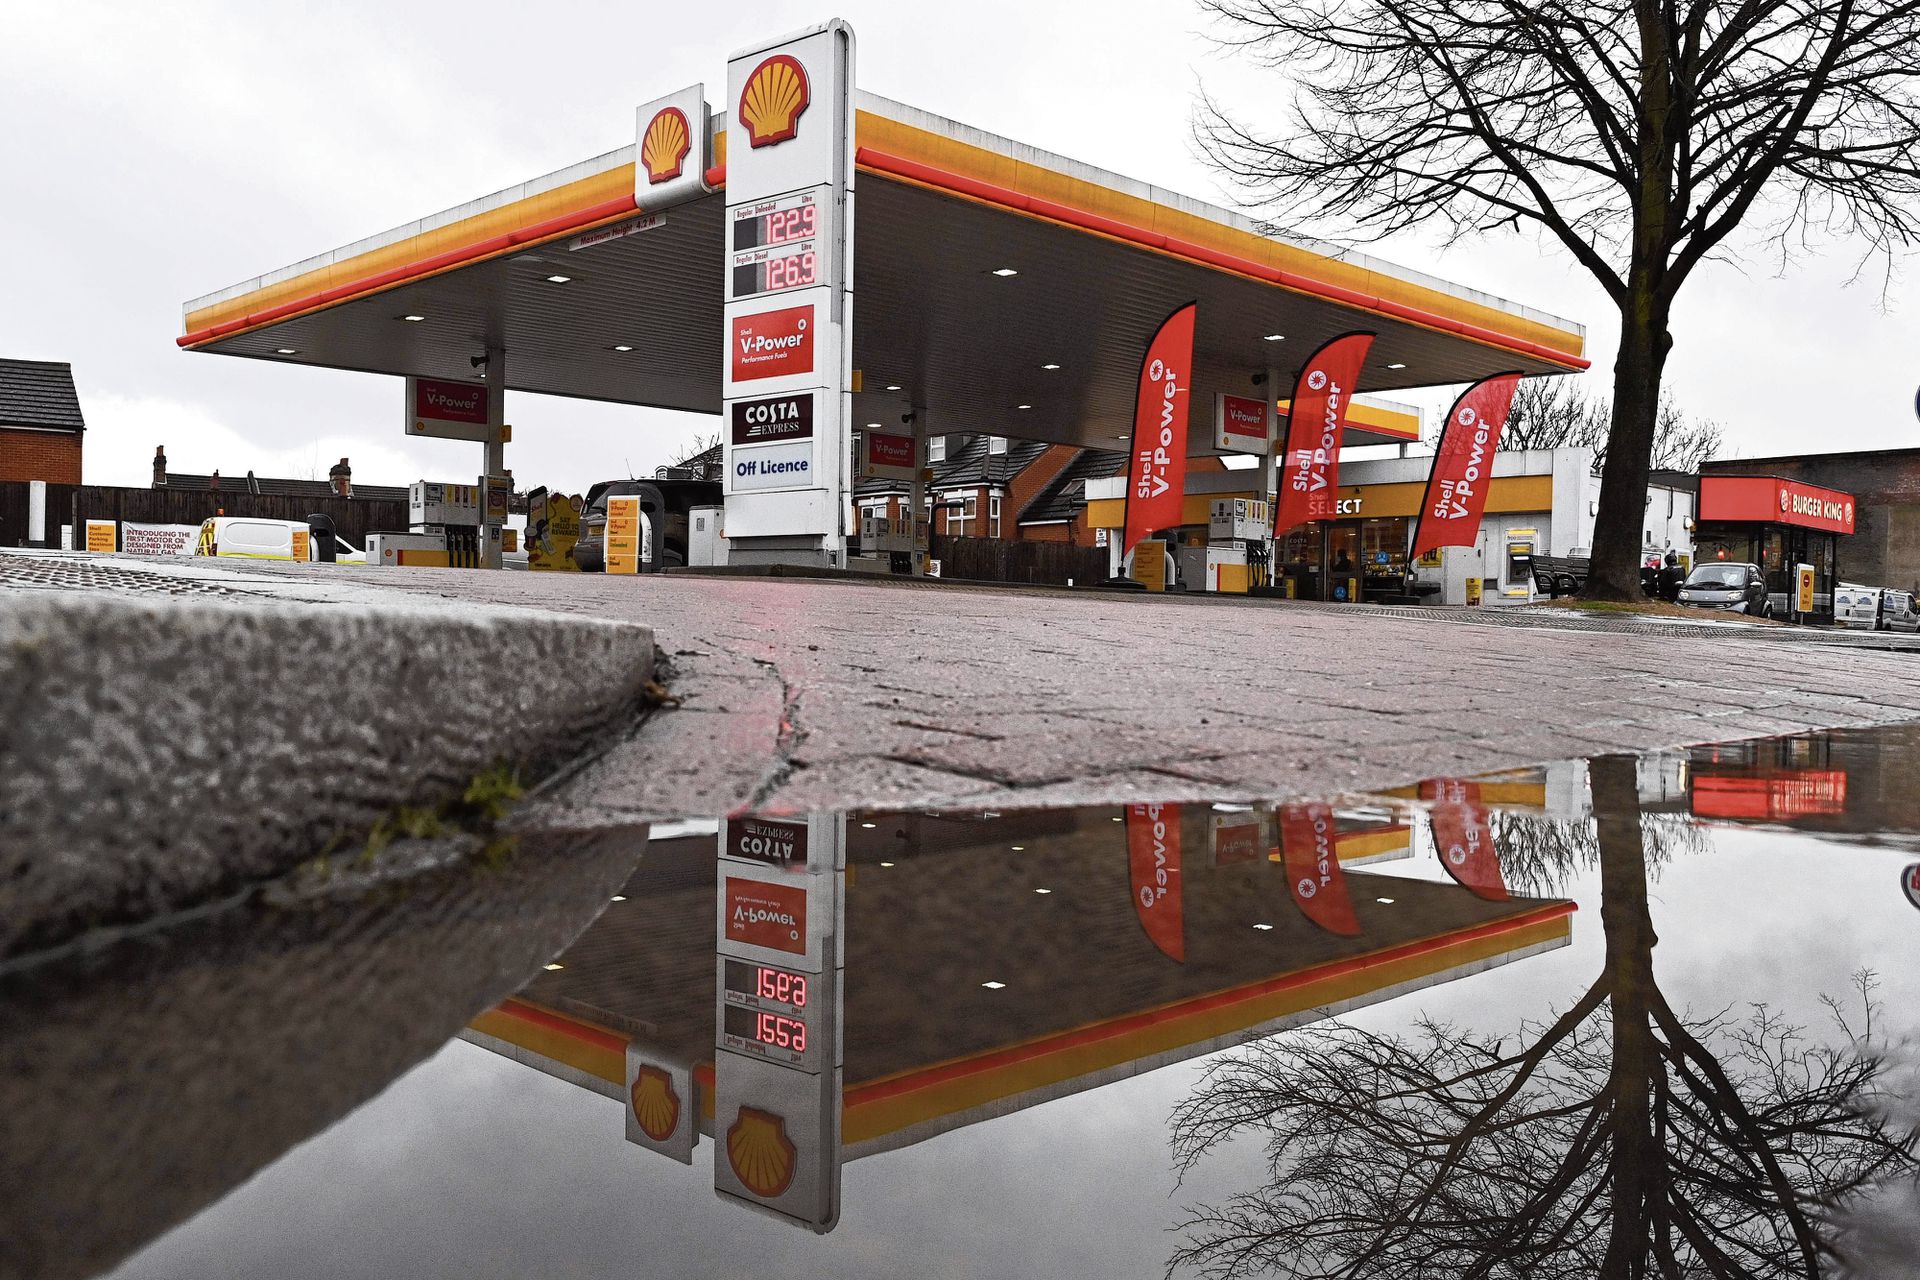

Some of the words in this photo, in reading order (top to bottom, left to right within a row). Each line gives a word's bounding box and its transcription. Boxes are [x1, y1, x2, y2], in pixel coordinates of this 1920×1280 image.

[737, 208, 753, 218] Regular
[755, 203, 776, 214] Unleaded
[580, 231, 611, 245] Maximum
[612, 223, 633, 236] Height
[636, 219, 647, 229] 4.2
[766, 205, 815, 244] 122.9
[736, 256, 752, 264] Regular
[754, 251, 768, 261] Diesel
[766, 252, 815, 290] 126.9
[740, 328, 753, 336] Shell
[741, 333, 804, 354] V-Power
[741, 354, 774, 364] Performance
[774, 351, 788, 360] Fuels
[427, 393, 477, 409] V-Power
[745, 401, 799, 424] COSTA
[1230, 409, 1261, 423] V-Power
[761, 421, 799, 435] EXPRESS
[1152, 368, 1176, 498] V-Power
[1309, 381, 1341, 492] V-Power
[737, 461, 757, 477] Off
[760, 460, 808, 475] Licence
[1138, 451, 1152, 498] Shell
[1293, 449, 1312, 492] Shell
[1449, 419, 1490, 520] V-Power
[1308, 499, 1362, 516] SELECT
[1434, 479, 1455, 519] Shell
[1793, 494, 1822, 517] BURGER
[1823, 500, 1842, 521] KING
[126, 529, 177, 538] INTRODUCING
